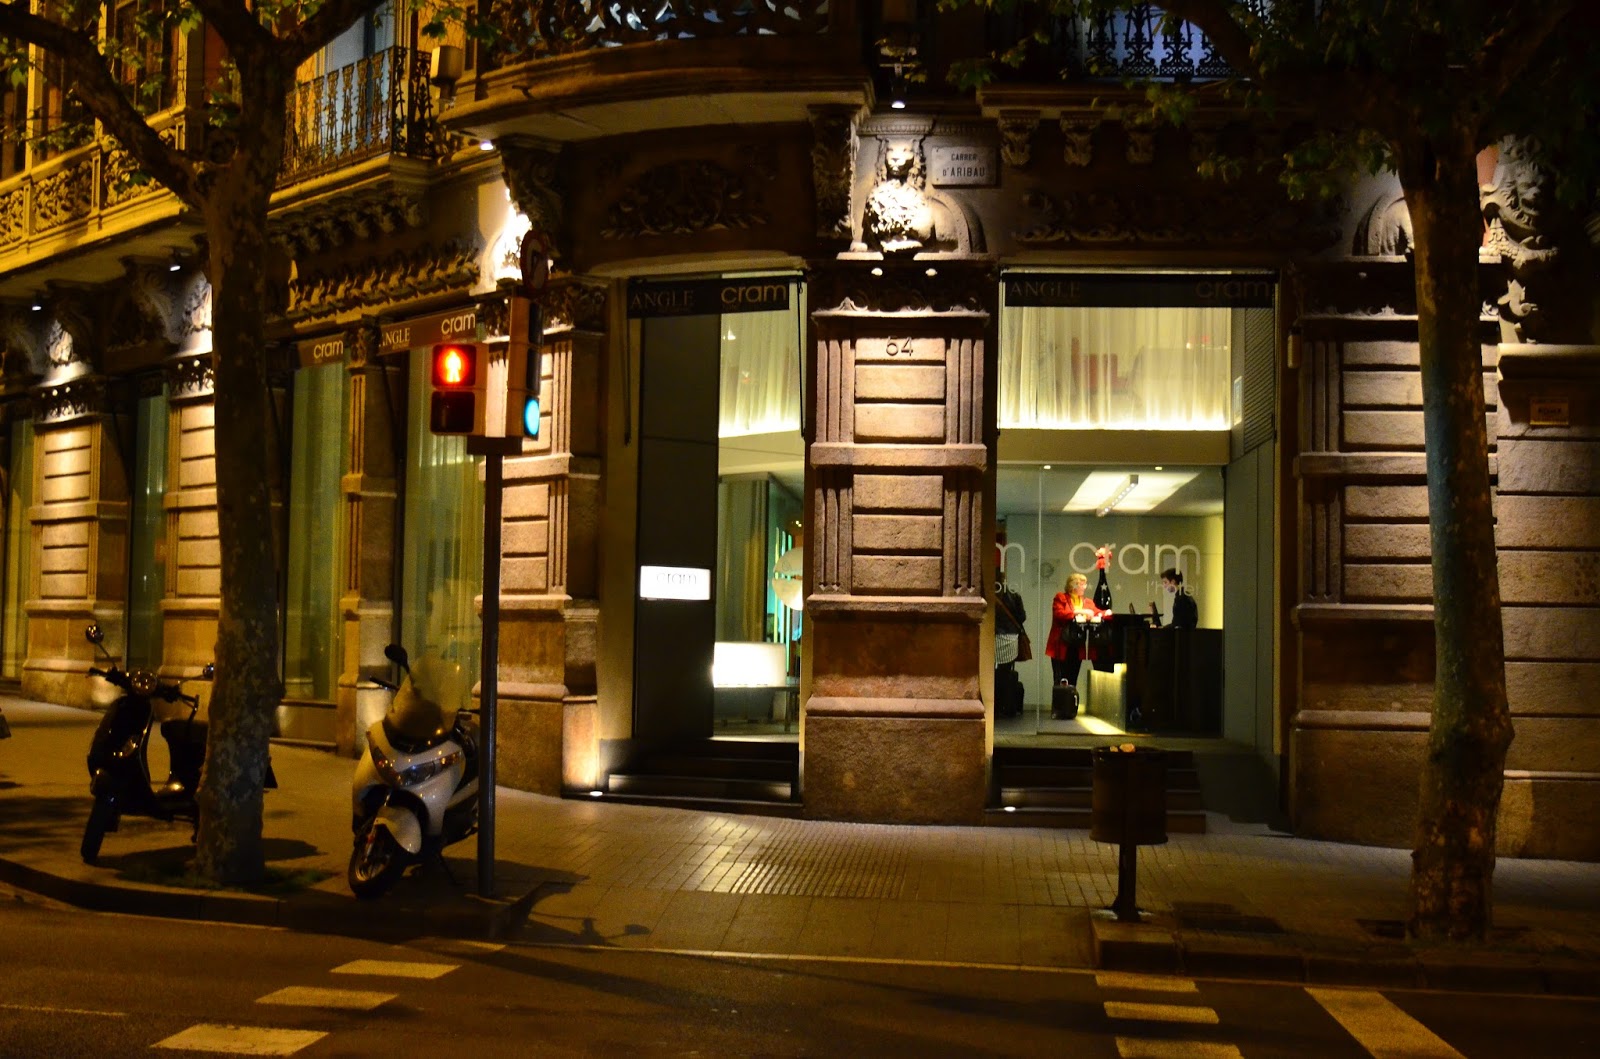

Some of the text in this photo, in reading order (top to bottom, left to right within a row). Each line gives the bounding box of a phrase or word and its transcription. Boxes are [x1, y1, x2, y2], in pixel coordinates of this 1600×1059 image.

[951, 153, 978, 161] CARRER
[632, 284, 787, 307] ANGLE cram
[1195, 279, 1270, 299] cram
[441, 313, 476, 335] cram
[313, 339, 344, 360] cram
[1068, 541, 1200, 575] cram
